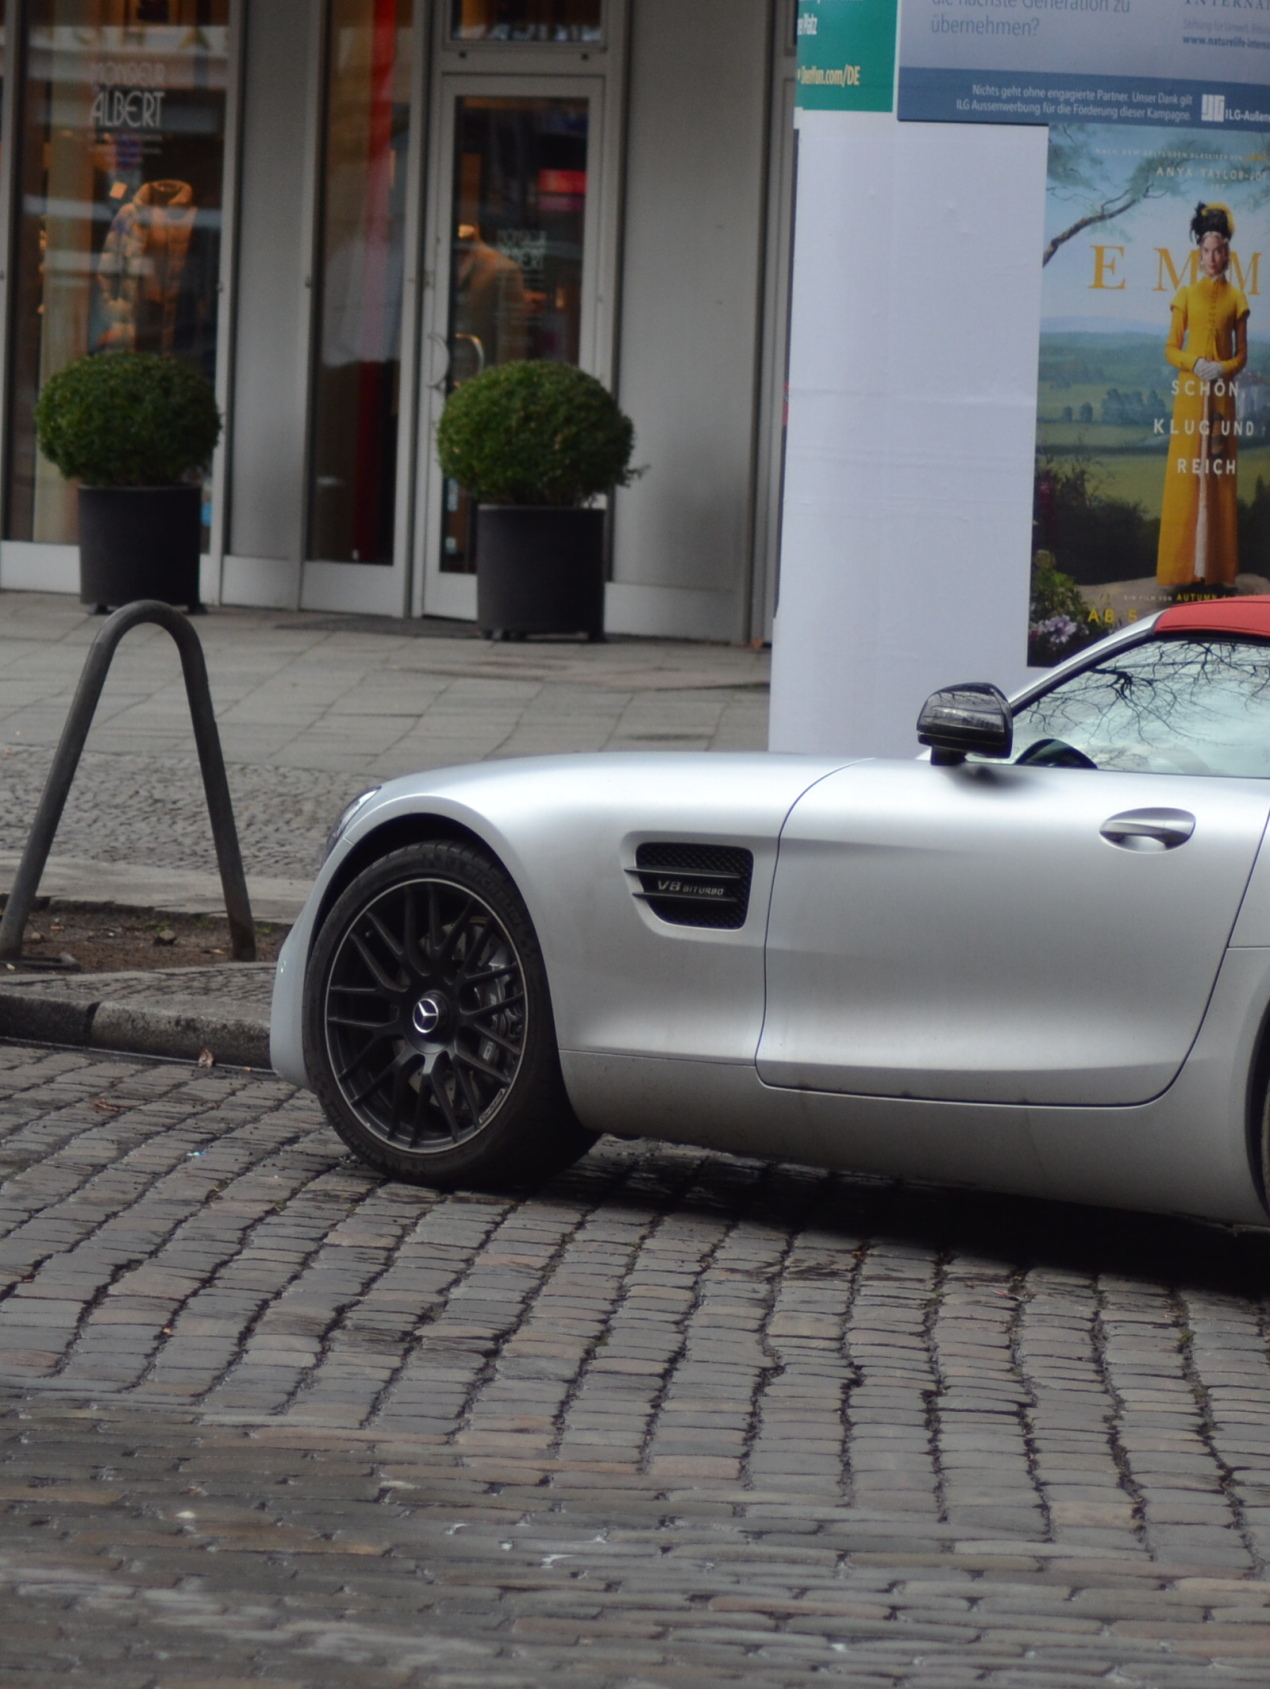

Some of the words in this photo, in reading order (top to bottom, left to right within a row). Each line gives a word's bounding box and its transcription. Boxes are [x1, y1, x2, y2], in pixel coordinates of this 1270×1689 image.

[1114, 0, 1130, 13] zu
[931, 14, 1040, 36] übernehmen?
[972, 84, 999, 96] Nichts
[1001, 86, 1021, 99] geht
[1023, 87, 1045, 98] ohne
[1047, 89, 1095, 102] engagierte
[1132, 92, 1156, 103] Unser
[1158, 93, 1178, 104] Dank
[1180, 94, 1193, 107] gilt
[88, 90, 166, 128] ALBERT
[956, 99, 970, 110] ILG
[972, 100, 1040, 116] Aussenwerbung
[1043, 102, 1055, 113] für
[1057, 103, 1072, 114] die
[1074, 104, 1118, 119] Förderung
[1120, 106, 1145, 117] dieser
[1155, 166, 1193, 178] ANYA
[1200, 168, 1268, 181] TAYLOR-JOY
[1153, 417, 1211, 436] KLUG
[1220, 419, 1256, 437] UND
[1177, 457, 1237, 476] REICH
[1176, 592, 1218, 602] AUTUMN
[1087, 608, 1115, 623] AB
[657, 879, 681, 891] V8
[682, 884, 724, 896] BITURBO
